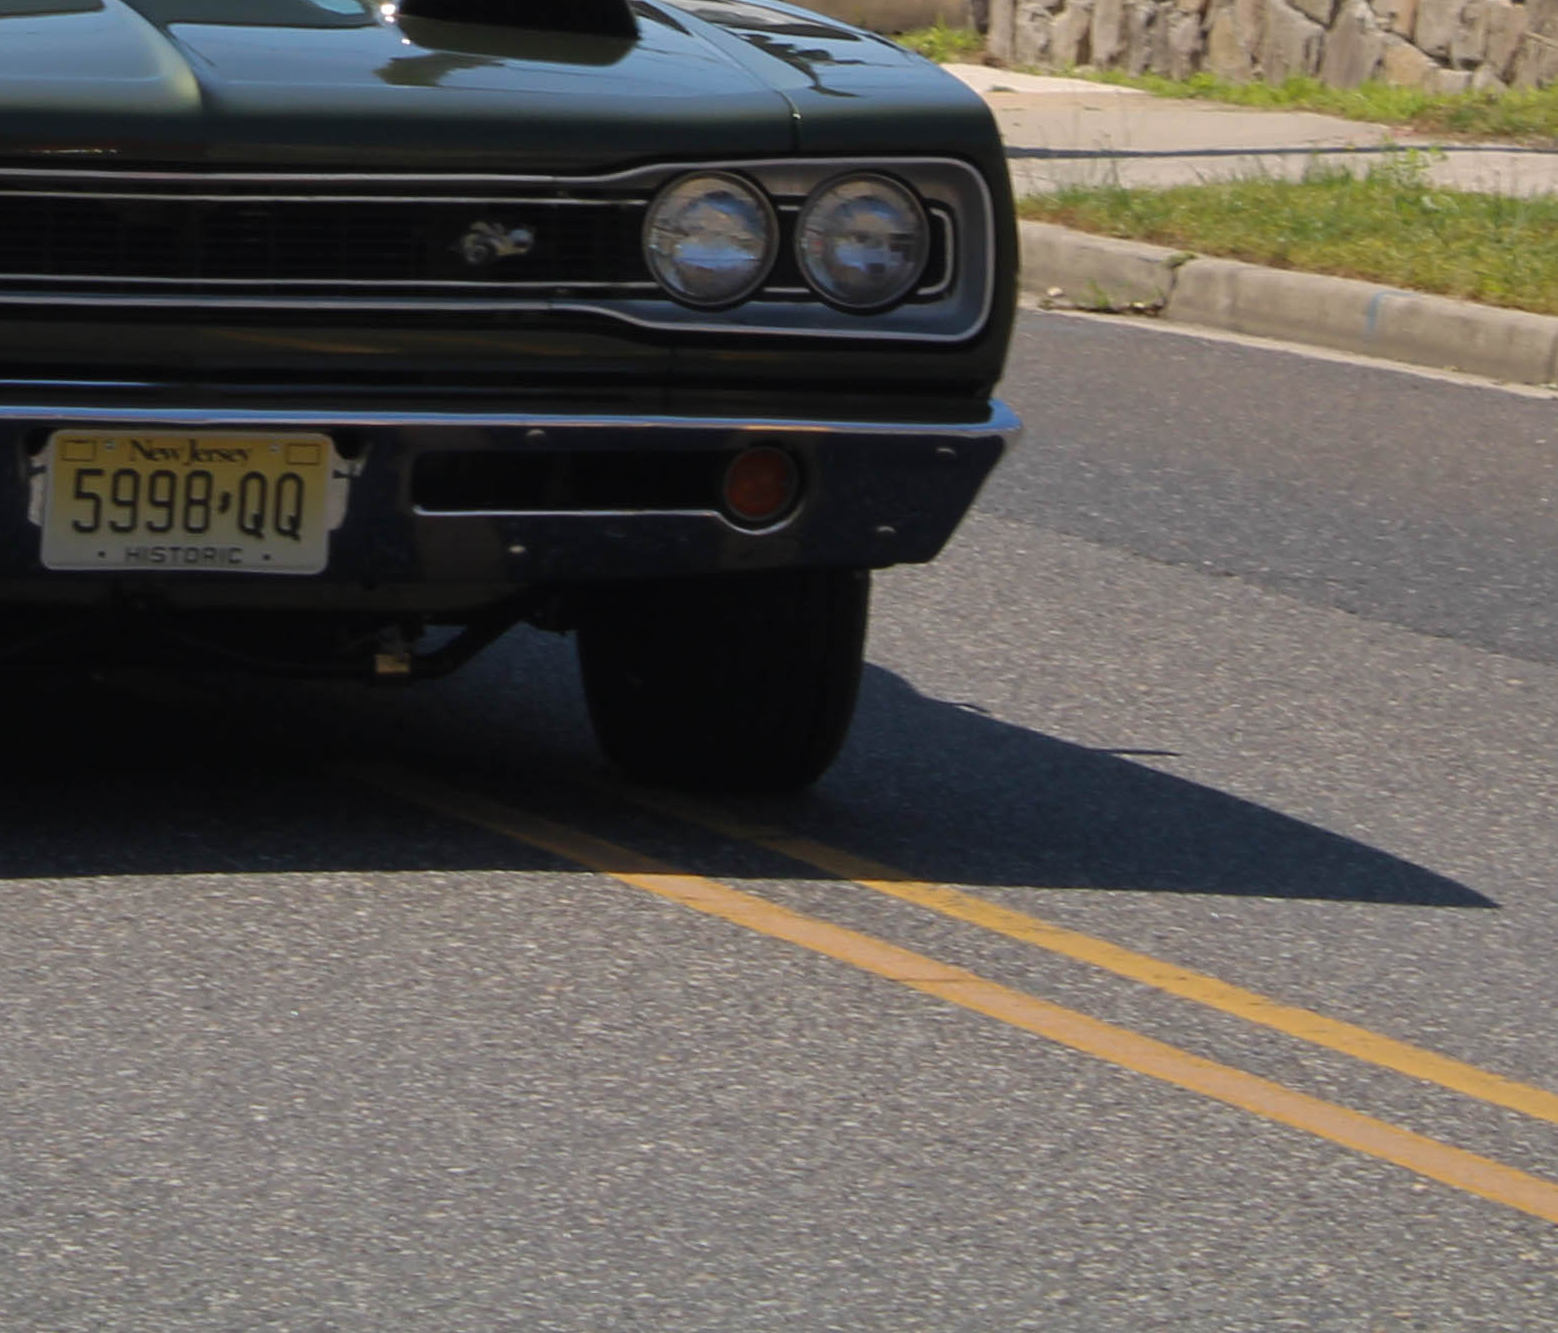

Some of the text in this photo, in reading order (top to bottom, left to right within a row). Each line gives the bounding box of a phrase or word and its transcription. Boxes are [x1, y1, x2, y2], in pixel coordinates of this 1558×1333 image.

[129, 439, 251, 465] New Jersey
[126, 546, 244, 564] HISTORIC
